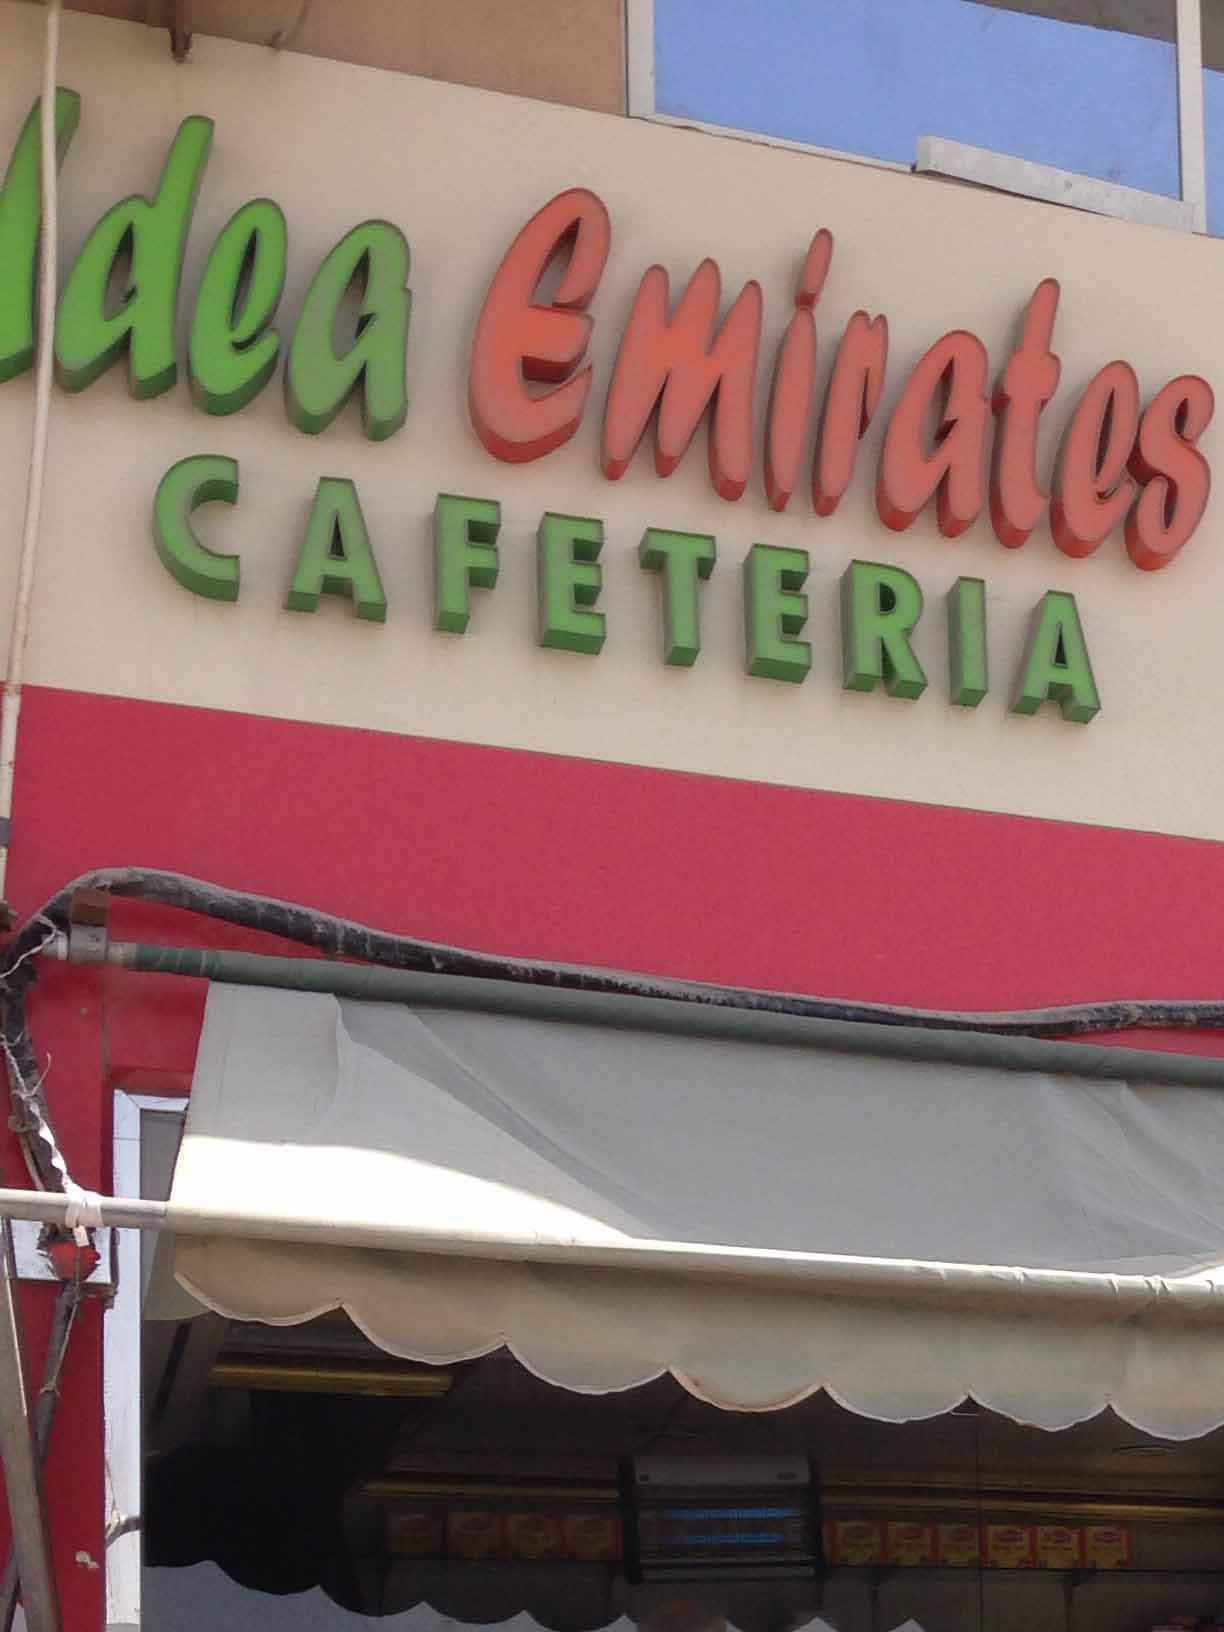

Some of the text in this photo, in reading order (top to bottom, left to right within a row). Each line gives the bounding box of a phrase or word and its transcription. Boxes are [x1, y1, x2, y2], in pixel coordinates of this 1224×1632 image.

[0, 86, 1216, 571] Idea Emirates
[153, 453, 1101, 724] CAFETERIA
